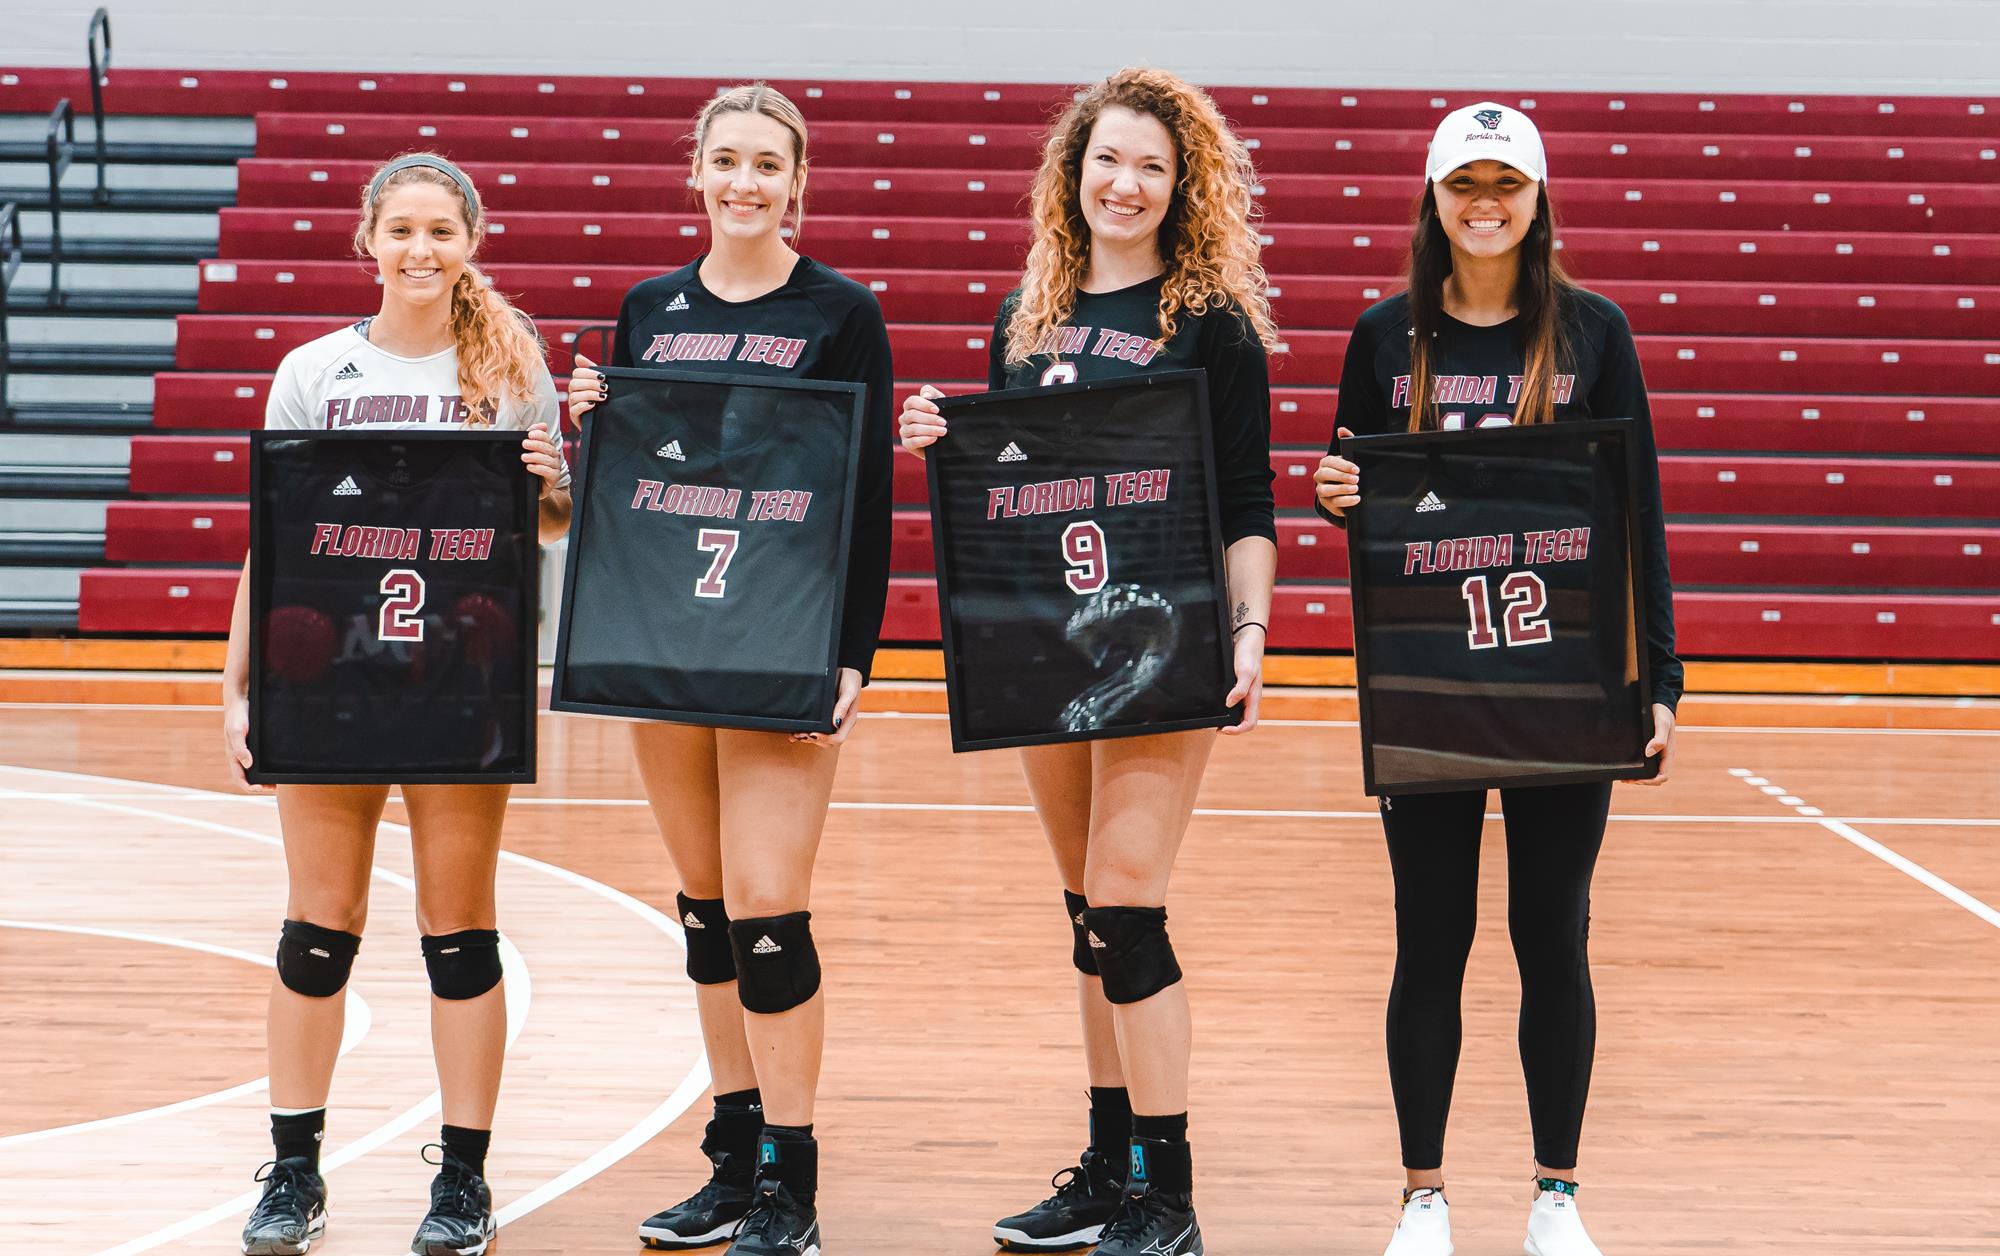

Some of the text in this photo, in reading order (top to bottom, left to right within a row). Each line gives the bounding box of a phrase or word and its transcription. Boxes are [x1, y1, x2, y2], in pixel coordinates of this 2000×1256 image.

[1465, 132, 1511, 142] Florida Tech
[665, 302, 690, 312] adidas
[642, 332, 807, 368] FLORIDA TECH
[1091, 328, 1160, 366] TECH
[335, 372, 364, 380] adidas
[1392, 375, 1575, 408] FLRIDA TH
[326, 395, 500, 430] FLORIDA TEH
[656, 448, 686, 462] adidas
[997, 452, 1028, 463] adidas
[333, 487, 362, 496] adidas
[631, 479, 812, 522] FLORIDA TECH
[987, 469, 1171, 520] FLORIDA TECH
[1415, 502, 1446, 513] adidas
[310, 522, 495, 561] FLORIDA TECH
[1061, 520, 1109, 595] 9
[1404, 527, 1591, 575] FLORIDA TECH
[694, 528, 740, 598] 7
[378, 569, 425, 642] 2
[1461, 570, 1552, 650] 12
[752, 944, 782, 954] adidas
